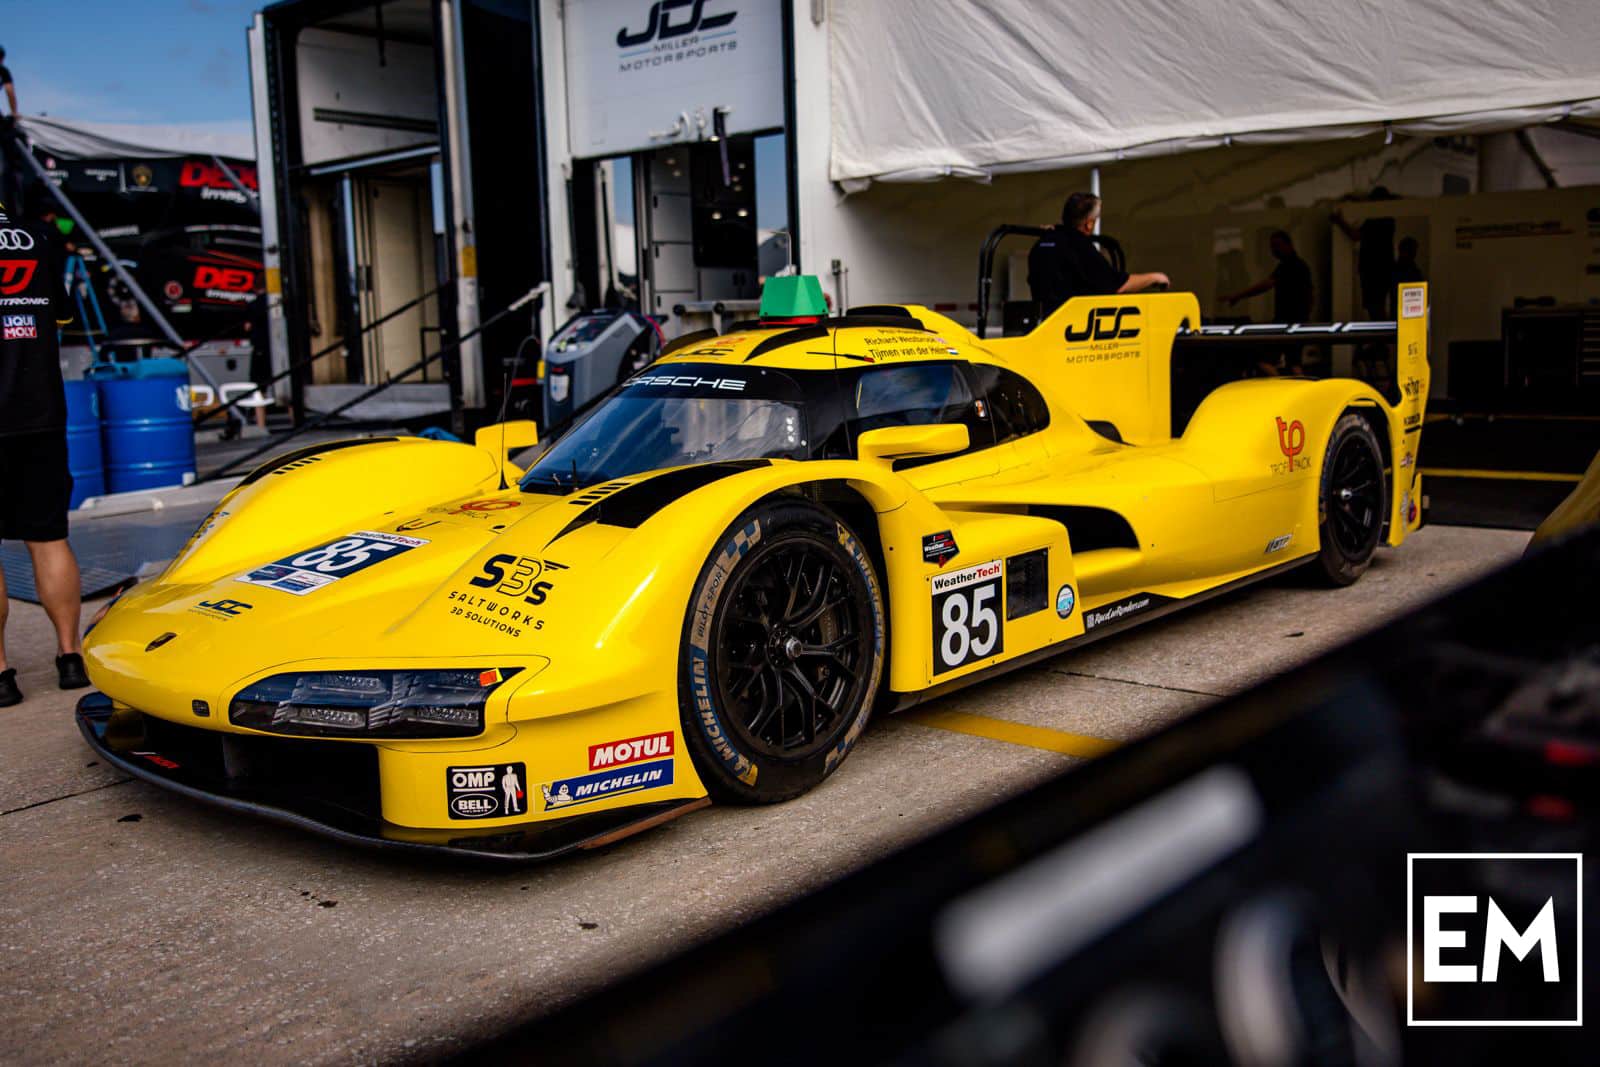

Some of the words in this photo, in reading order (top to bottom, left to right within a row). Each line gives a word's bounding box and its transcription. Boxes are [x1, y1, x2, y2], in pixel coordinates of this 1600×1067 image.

[619, 41, 738, 72] MOTORSPORTS
[653, 36, 699, 52] MILLER
[3, 315, 34, 327] LIQUI
[4, 327, 35, 338] MOLY
[1064, 306, 1142, 343] JDC
[1066, 351, 1141, 363] MOTORSPORTS
[1089, 343, 1119, 351] MILLER
[291, 538, 398, 572] 85
[934, 564, 1000, 590] WeatherTech
[448, 591, 545, 630] SALTWORKS
[450, 606, 464, 616] 3D
[464, 611, 521, 638] SOLUTIONS
[940, 583, 998, 667] 85
[692, 657, 739, 764] MICHELIN
[593, 736, 670, 767] MOTUL
[452, 772, 495, 788] OMP
[575, 769, 663, 797] MICHELIN
[458, 798, 492, 811] BELL
